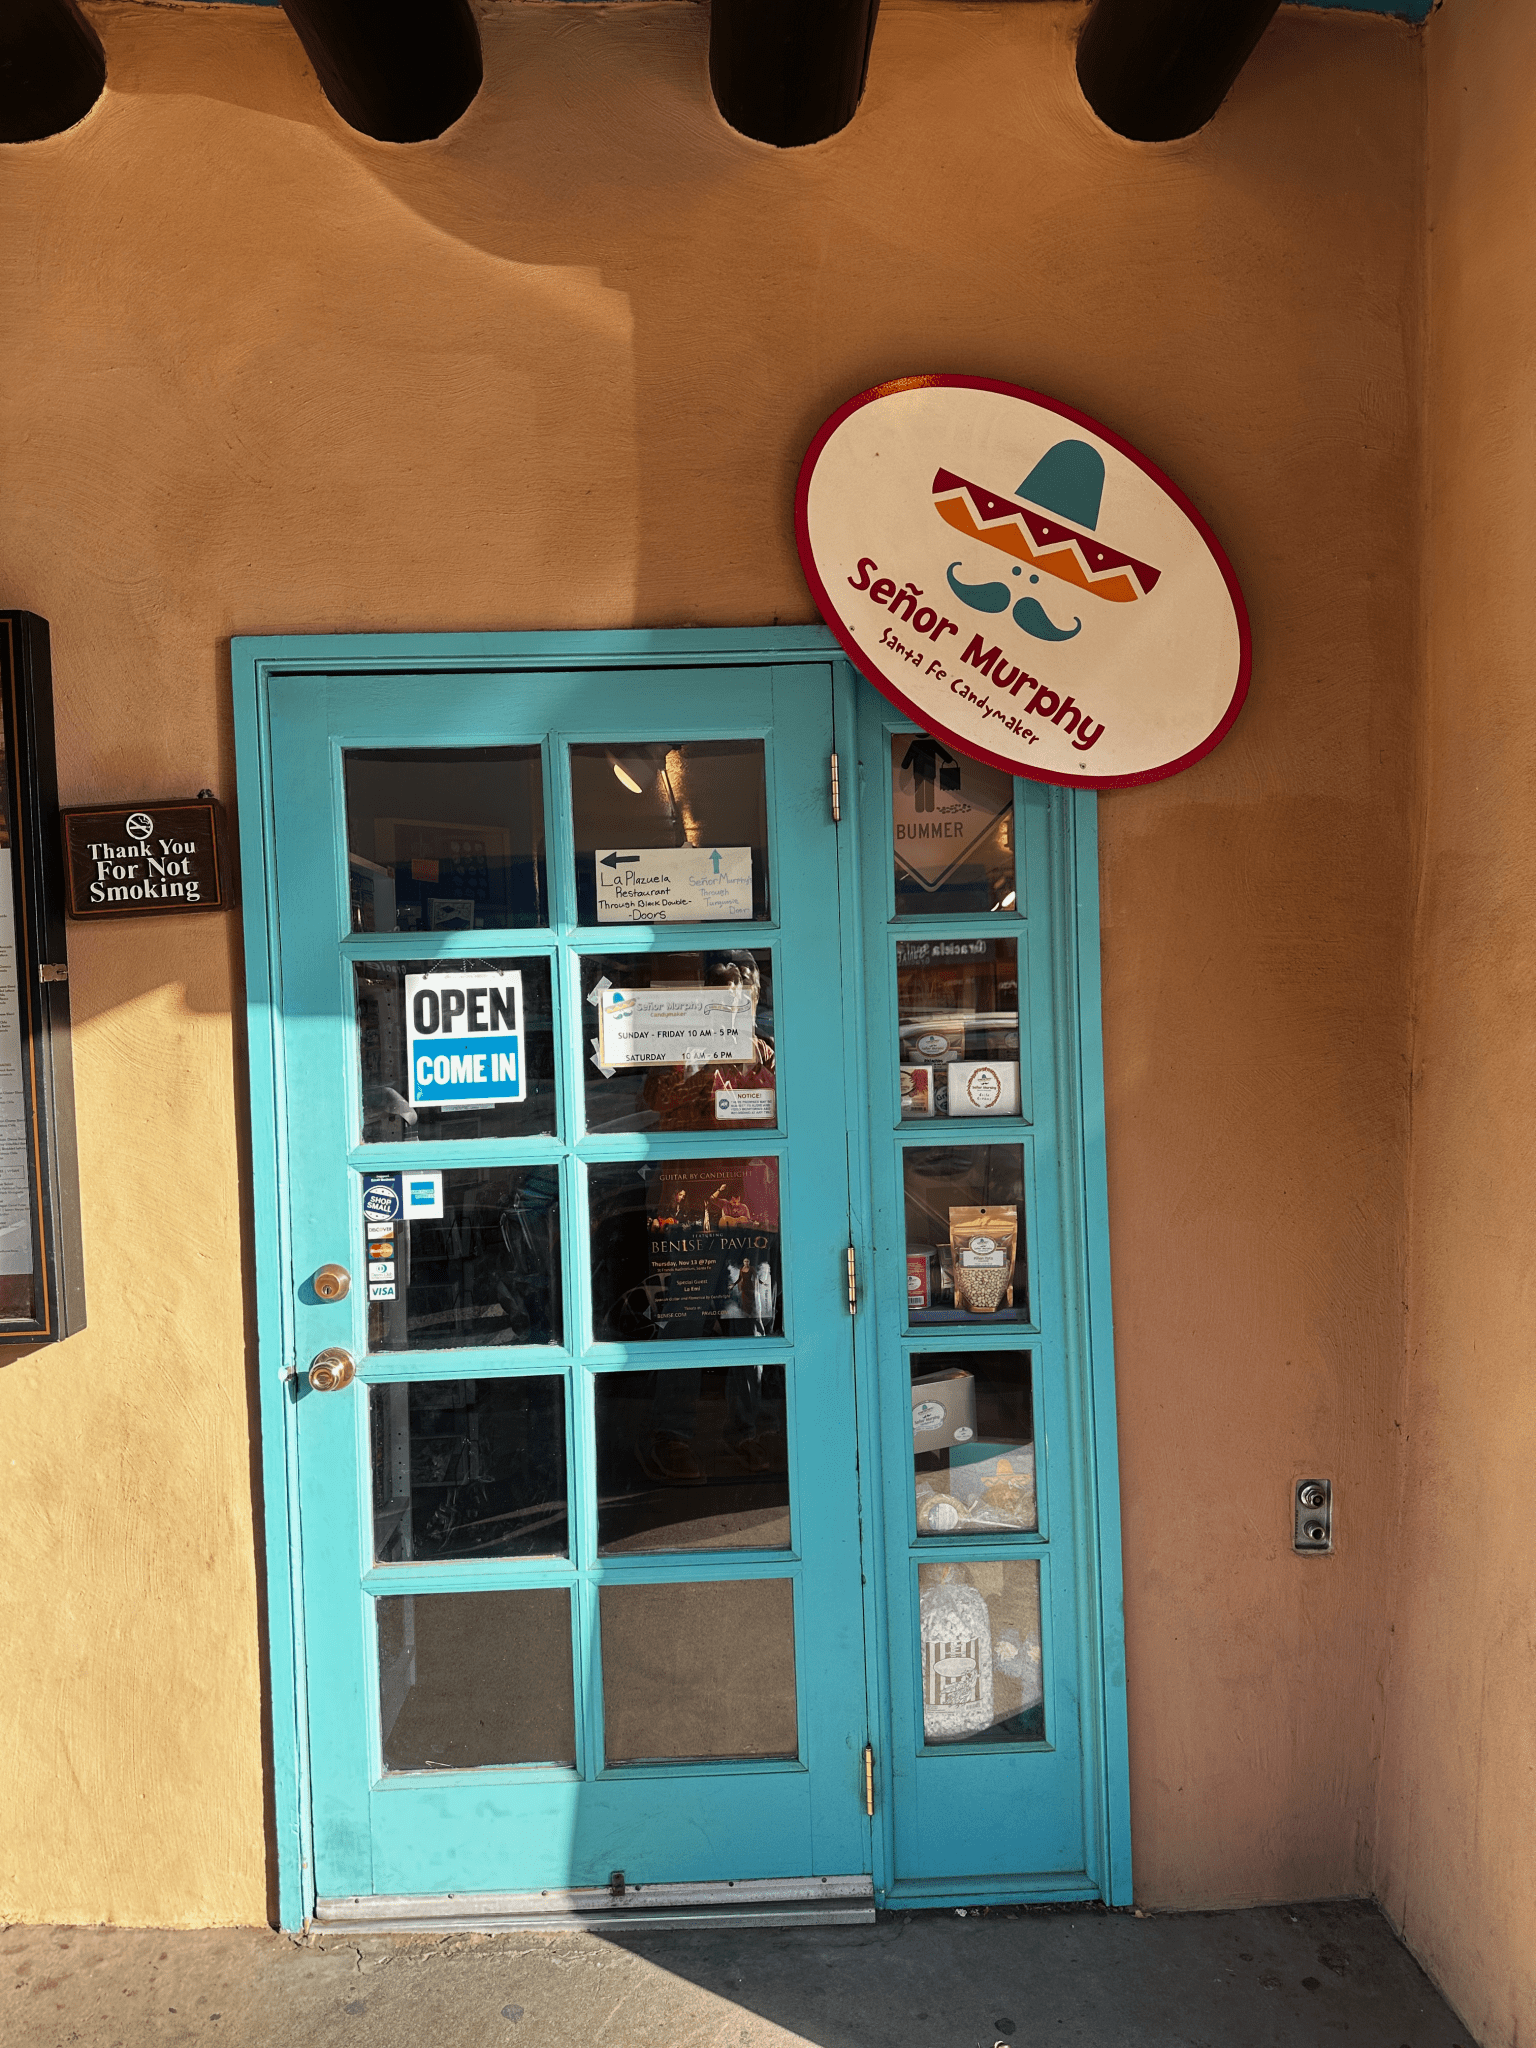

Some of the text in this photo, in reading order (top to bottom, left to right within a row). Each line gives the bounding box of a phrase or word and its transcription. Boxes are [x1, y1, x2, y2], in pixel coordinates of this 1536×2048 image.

[847, 557, 1105, 751] Señor Murphy
[879, 627, 1039, 745] Santa Fe Candymaker
[896, 821, 964, 840] BUMMER
[87, 838, 196, 860] Thank You
[96, 856, 191, 881] For Not
[600, 870, 671, 886] La Plazuela
[90, 877, 200, 903] Smoking
[616, 886, 671, 898] Restaurant
[699, 888, 730, 897] Through
[598, 900, 635, 909] Through
[413, 986, 516, 1035] OPEN
[636, 1002, 665, 1011] Señor
[667, 1002, 703, 1011] Murphy
[618, 1031, 649, 1039] SUNDAY
[657, 1030, 685, 1038] FRIDAY
[625, 1053, 666, 1061] SATURDAY
[681, 1052, 690, 1060] 10
[416, 1052, 516, 1086] COME IN
[700, 1171, 752, 1179] CANDLELIGHT
[366, 1202, 392, 1213] SMALL
[370, 1196, 392, 1205] SHOP
[652, 1239, 703, 1254] BENISE
[721, 1236, 768, 1249] PAVLO
[372, 1287, 394, 1296] VISA
